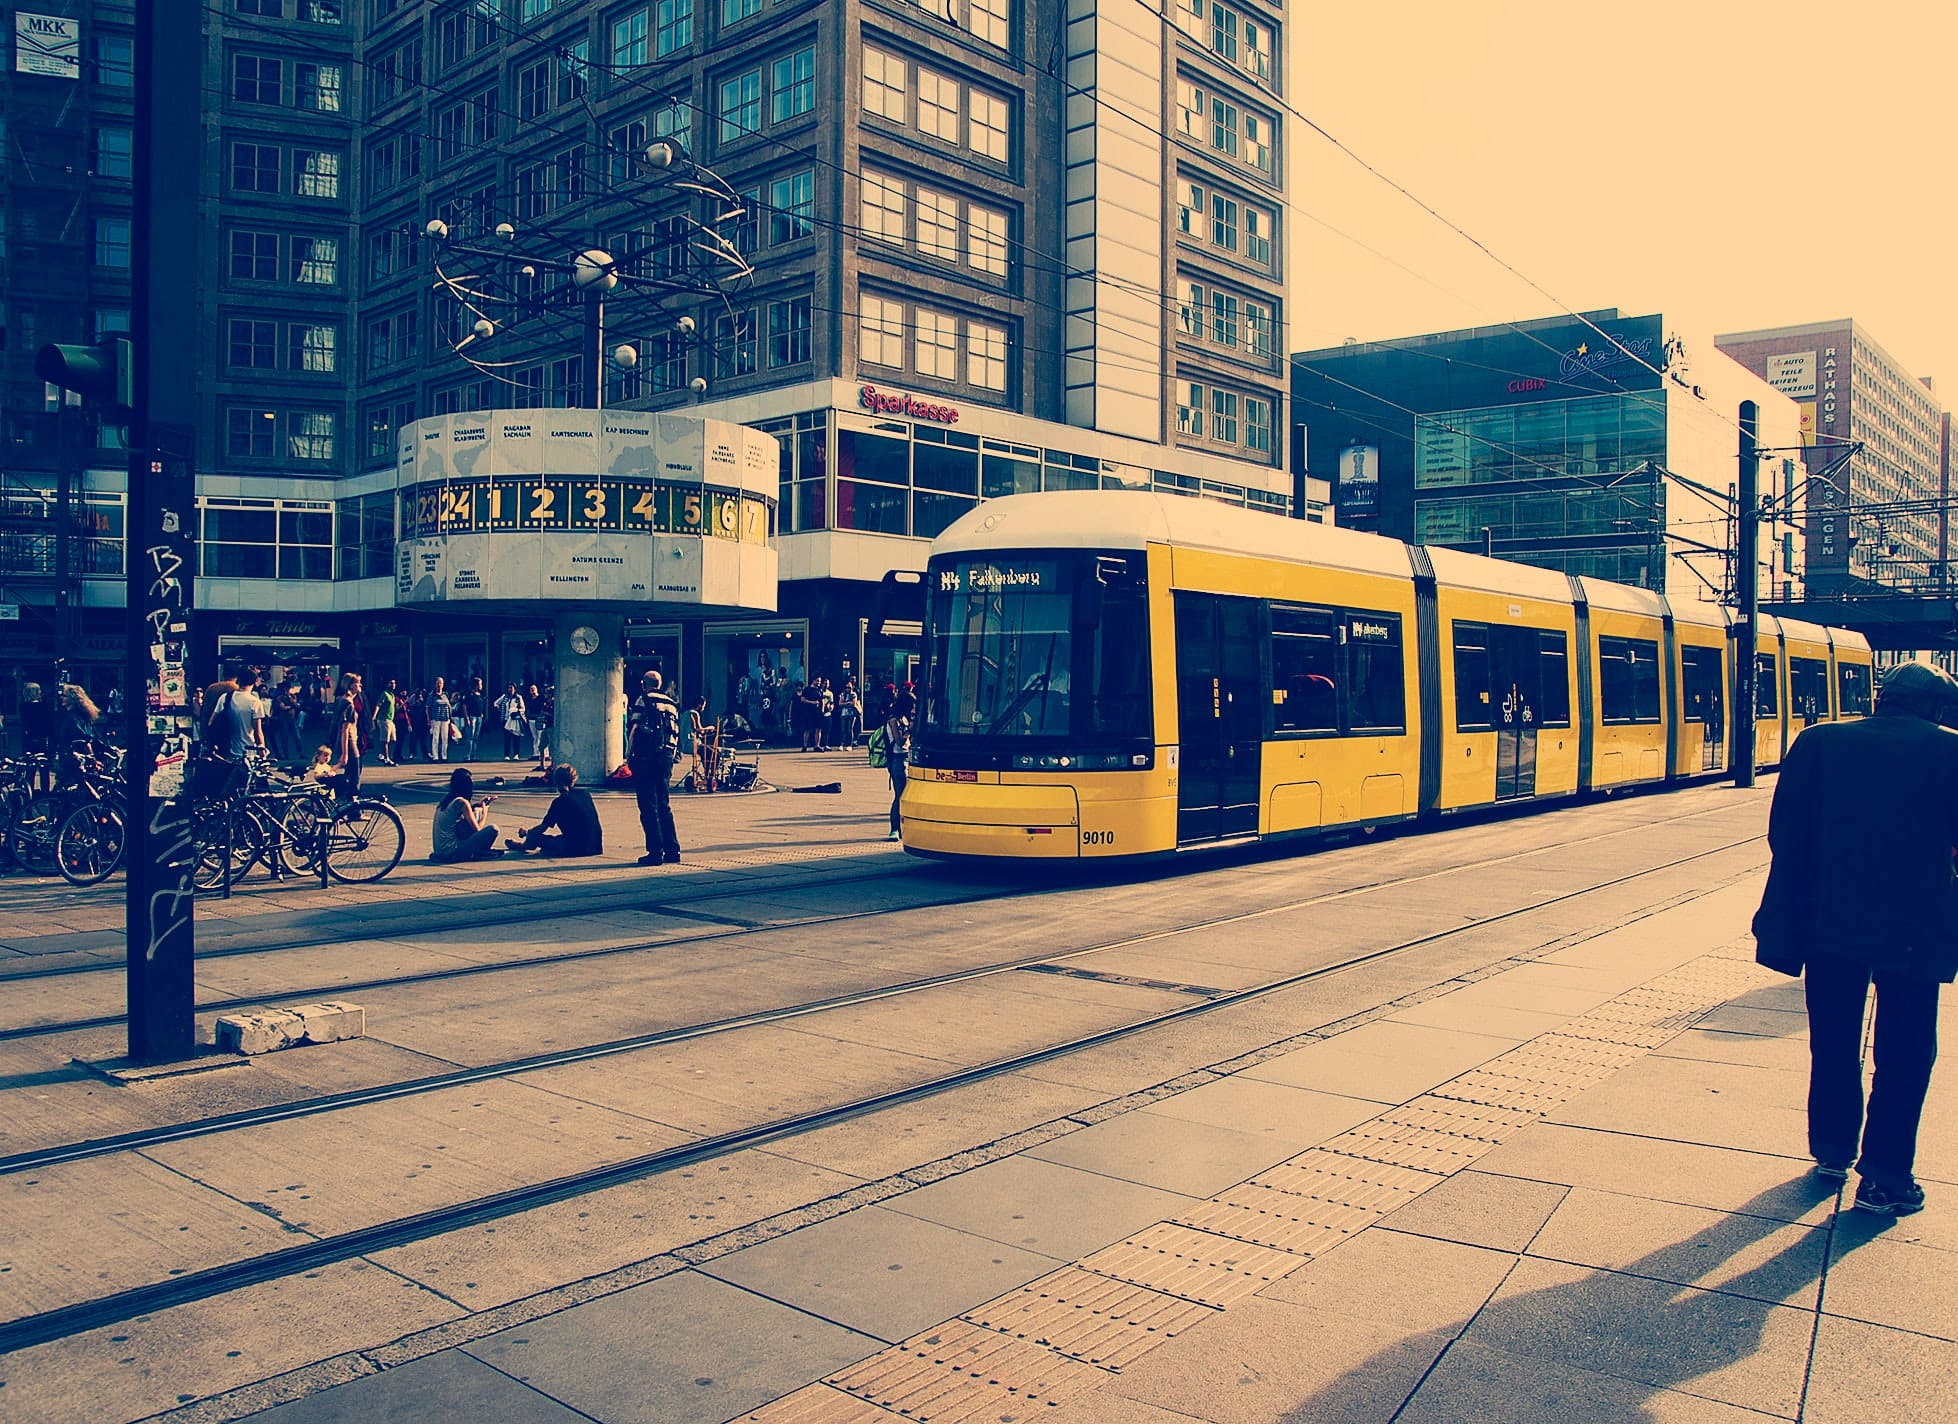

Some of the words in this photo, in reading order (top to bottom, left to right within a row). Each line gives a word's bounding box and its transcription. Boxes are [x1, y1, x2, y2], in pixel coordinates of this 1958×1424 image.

[29, 17, 66, 35] MKK
[1784, 358, 1804, 366] AUTO
[1781, 368, 1803, 376] TEILE
[1507, 378, 1546, 393] CUBIX
[1824, 347, 1836, 423] RATHAUS
[860, 385, 960, 424] Sparkasse
[418, 494, 437, 525] 23
[440, 490, 470, 521] 24
[487, 489, 501, 518] 1
[530, 488, 555, 518] 2
[584, 489, 606, 519] 3
[632, 492, 657, 521] 4
[684, 496, 701, 525] 5
[721, 500, 736, 531] 6
[1082, 831, 1114, 845] 9010
